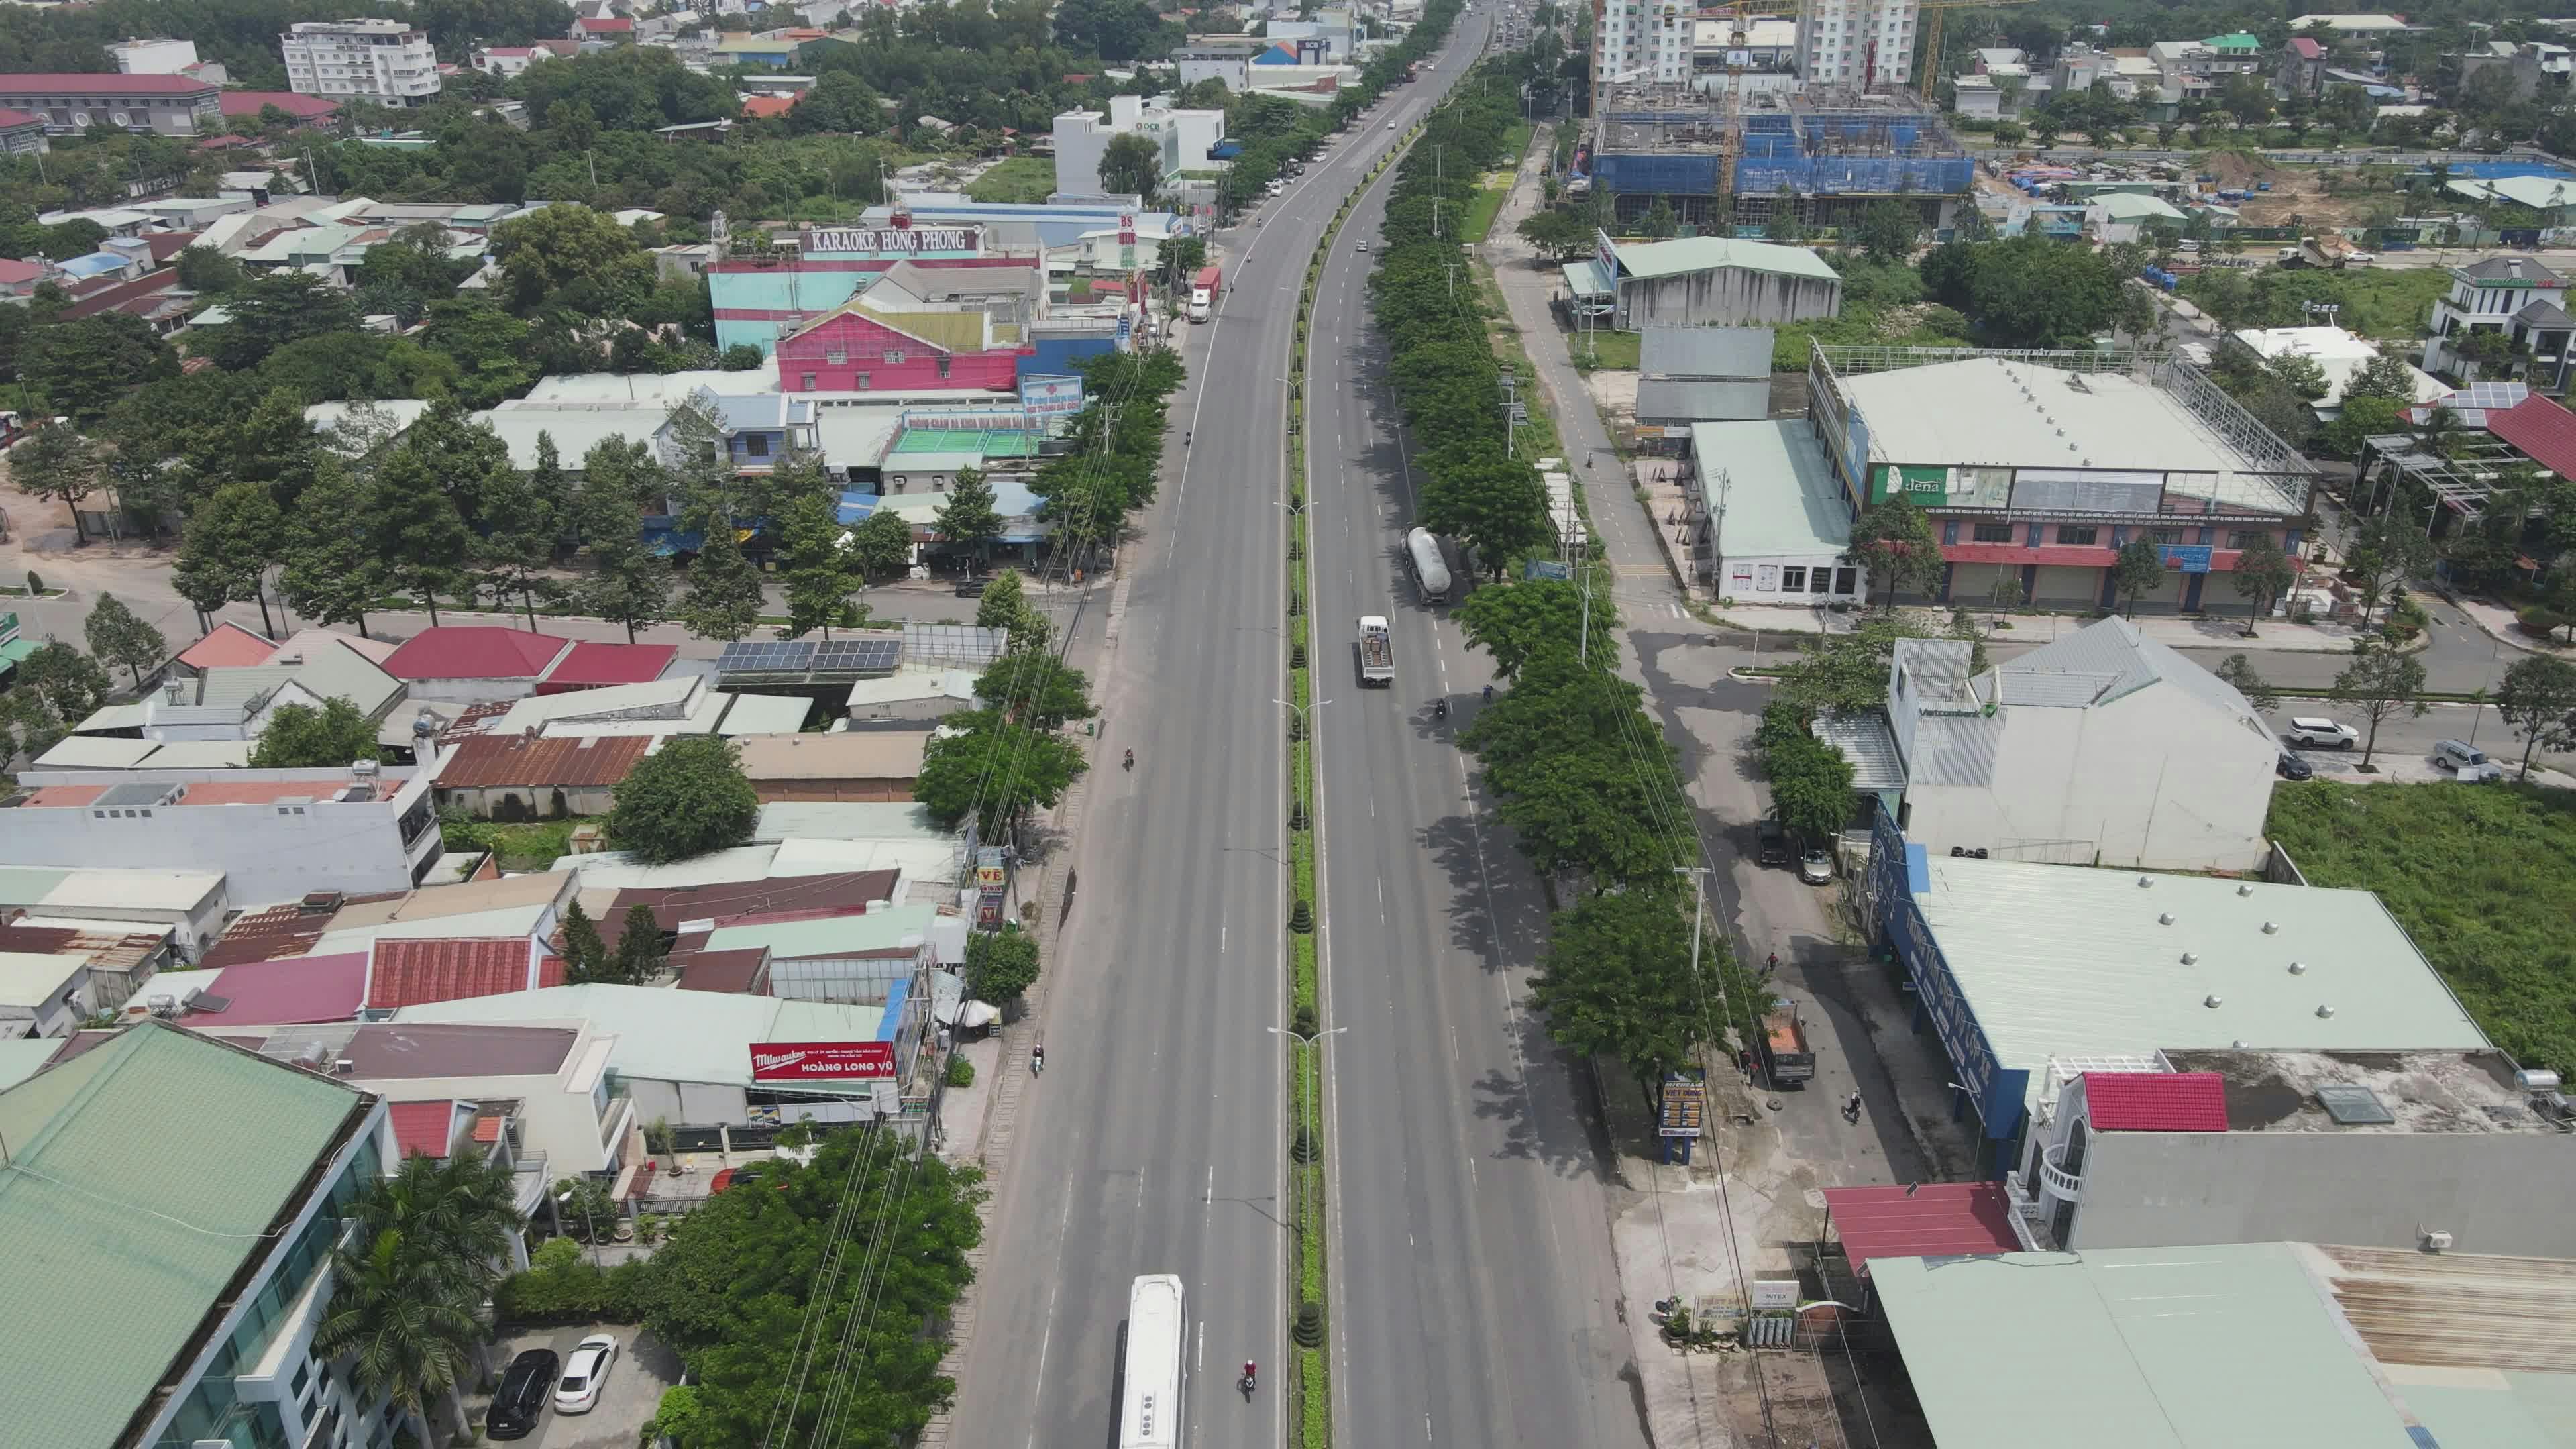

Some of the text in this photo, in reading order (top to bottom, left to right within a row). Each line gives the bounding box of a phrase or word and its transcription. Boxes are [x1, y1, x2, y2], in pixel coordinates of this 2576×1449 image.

[1121, 215, 1132, 227] BS
[812, 232, 877, 251] KARAOKE
[922, 231, 965, 250] PHONG
[1905, 478, 1940, 492] dena
[753, 1050, 806, 1067] Milwaukee
[802, 1060, 893, 1072] HOÀNG LONG VŨ
